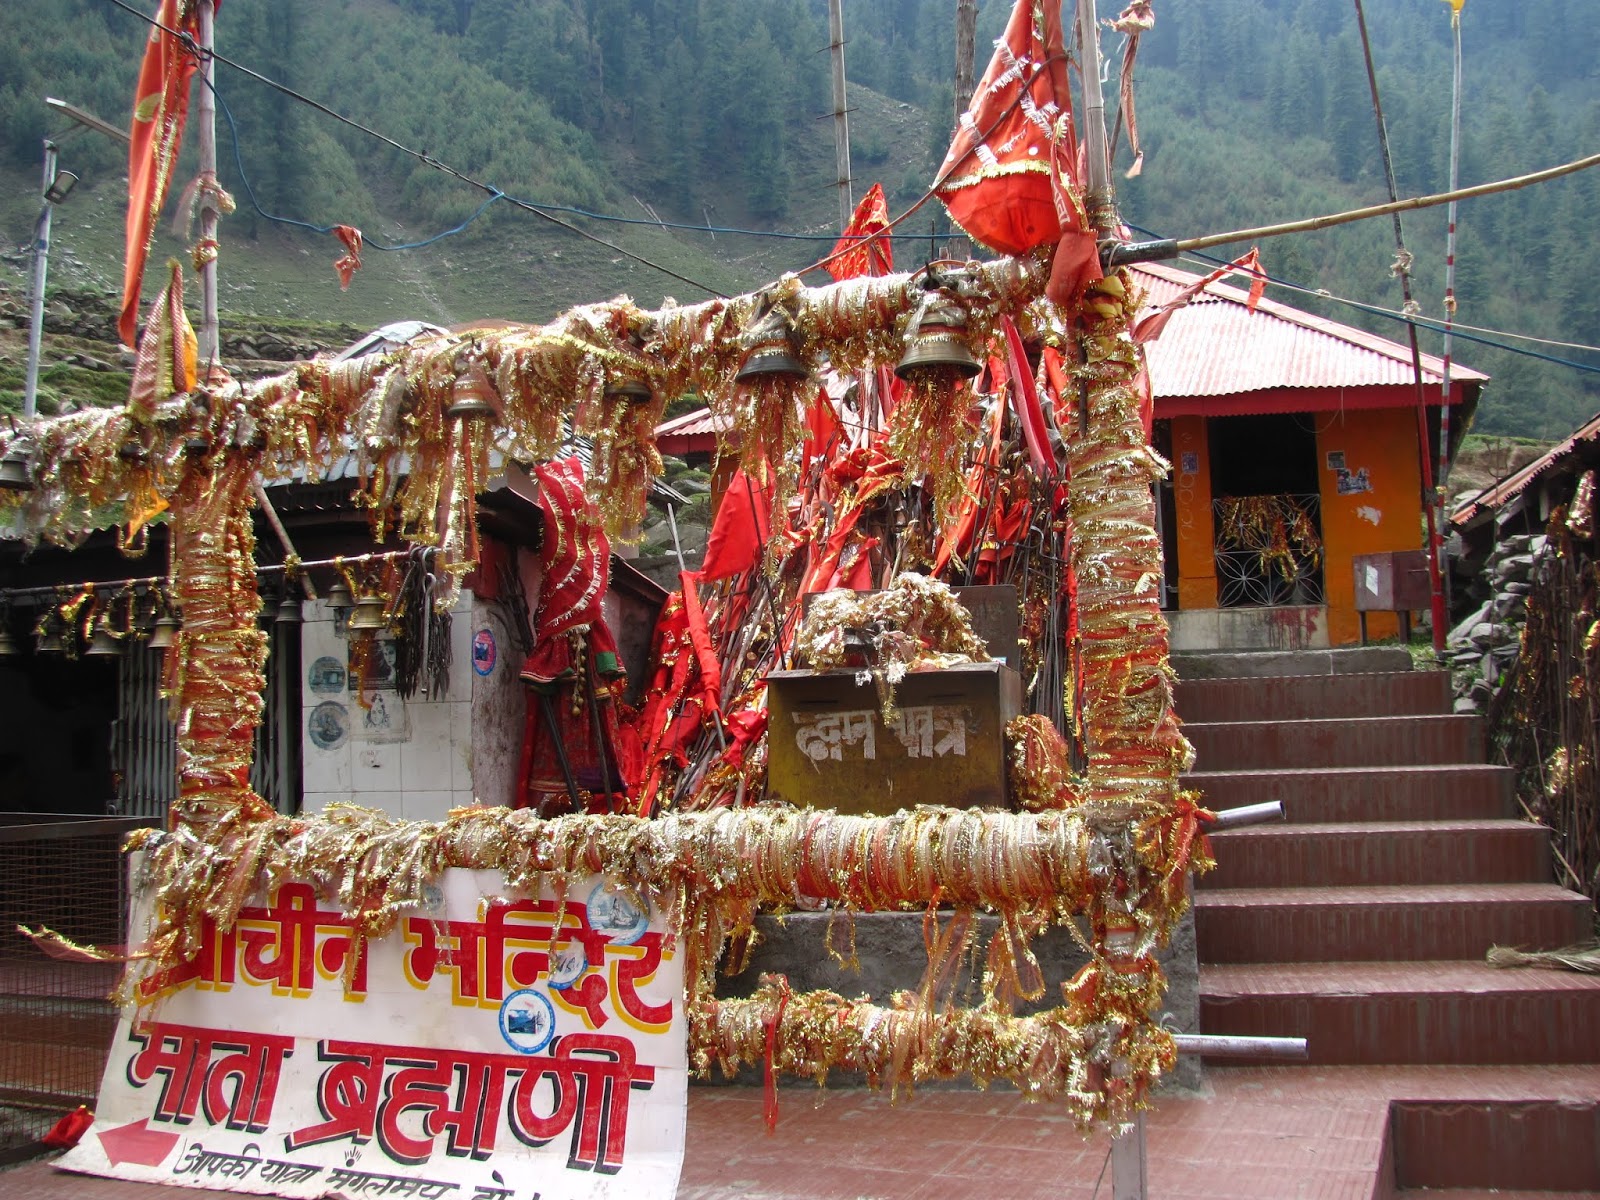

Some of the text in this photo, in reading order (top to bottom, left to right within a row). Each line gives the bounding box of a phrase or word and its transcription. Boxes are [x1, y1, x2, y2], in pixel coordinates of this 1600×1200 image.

[127, 1021, 656, 1175] माता ब्रह्माणी
[173, 1139, 264, 1181] आपकी
[260, 1159, 324, 1184] यात्रा
[325, 1147, 461, 1199] मंगलमय
